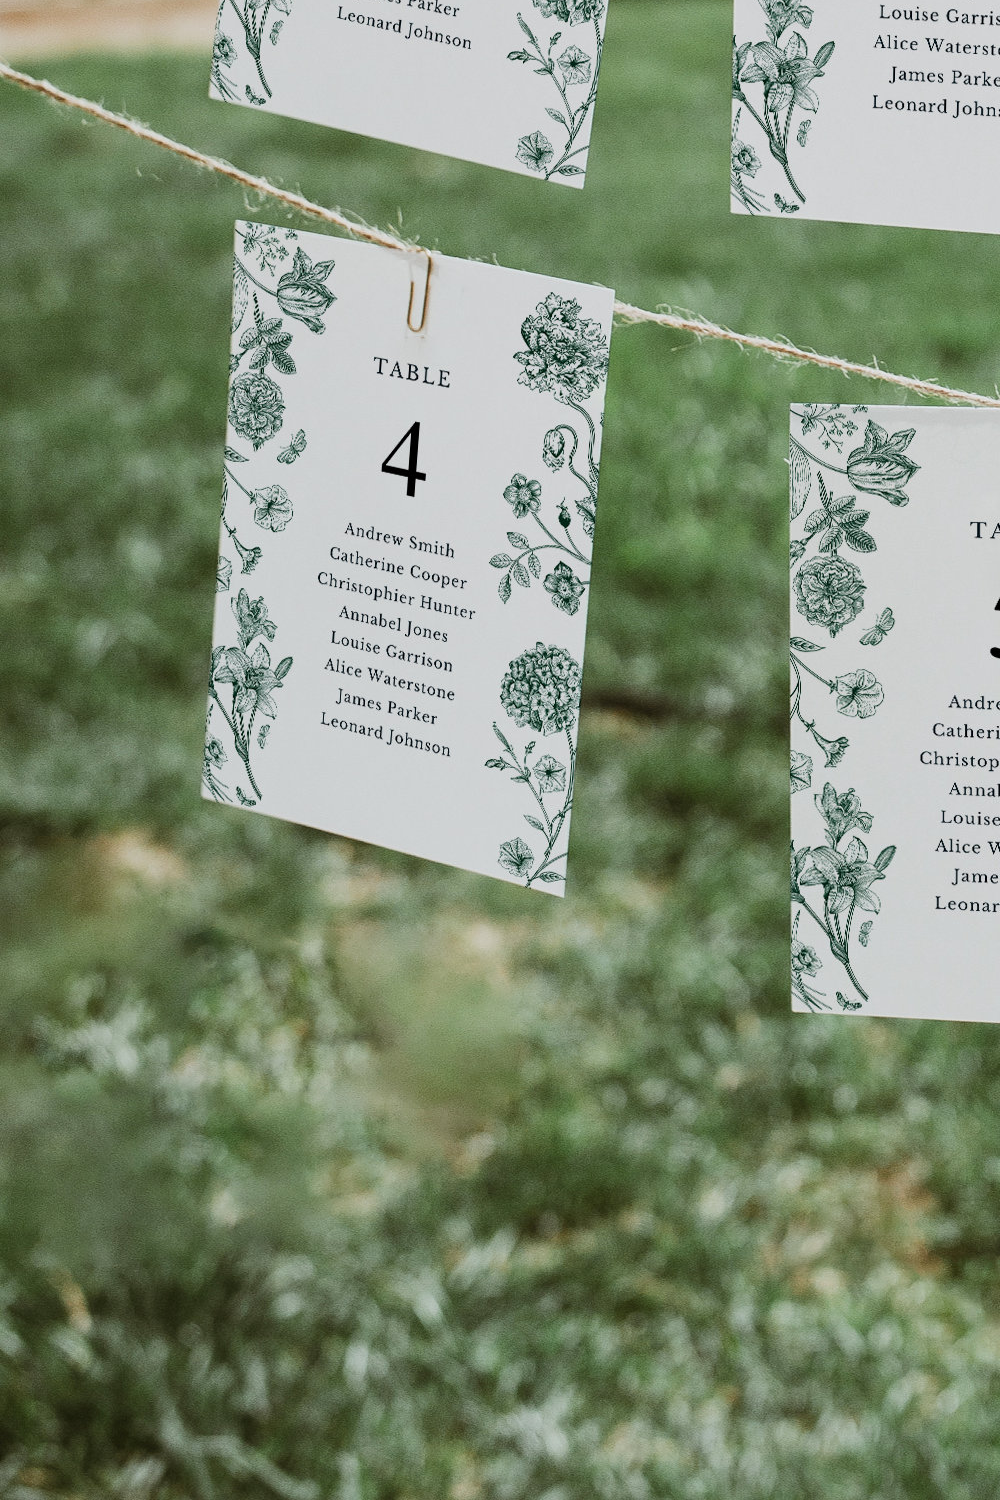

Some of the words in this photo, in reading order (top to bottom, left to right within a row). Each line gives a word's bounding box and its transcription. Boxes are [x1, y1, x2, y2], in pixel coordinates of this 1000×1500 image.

[336, 5, 403, 34] Leonard
[404, 22, 472, 50] Johnson
[879, 4, 940, 23] Louise
[873, 34, 919, 51] Alice
[888, 65, 944, 85] James
[872, 94, 948, 114] Leonard
[373, 356, 451, 389] TABLE
[380, 420, 427, 498] 4
[344, 522, 404, 546] Andrew
[408, 535, 455, 559] Smith
[329, 546, 405, 576] Catherine
[409, 564, 468, 590] Cooper
[317, 571, 416, 606] Christophier
[419, 594, 476, 620] Hunter
[338, 605, 402, 632] Annabel
[404, 620, 448, 643] Jones
[330, 629, 381, 655] Louise
[385, 644, 453, 673] Garrison
[323, 657, 363, 679] Alice
[367, 666, 455, 701] Waterstone
[335, 687, 382, 712] James
[387, 700, 438, 725] Parker
[320, 711, 384, 741] Leonard
[385, 728, 451, 758] Johnson
[940, 809, 1000, 827] Louise
[934, 837, 981, 855] Alice
